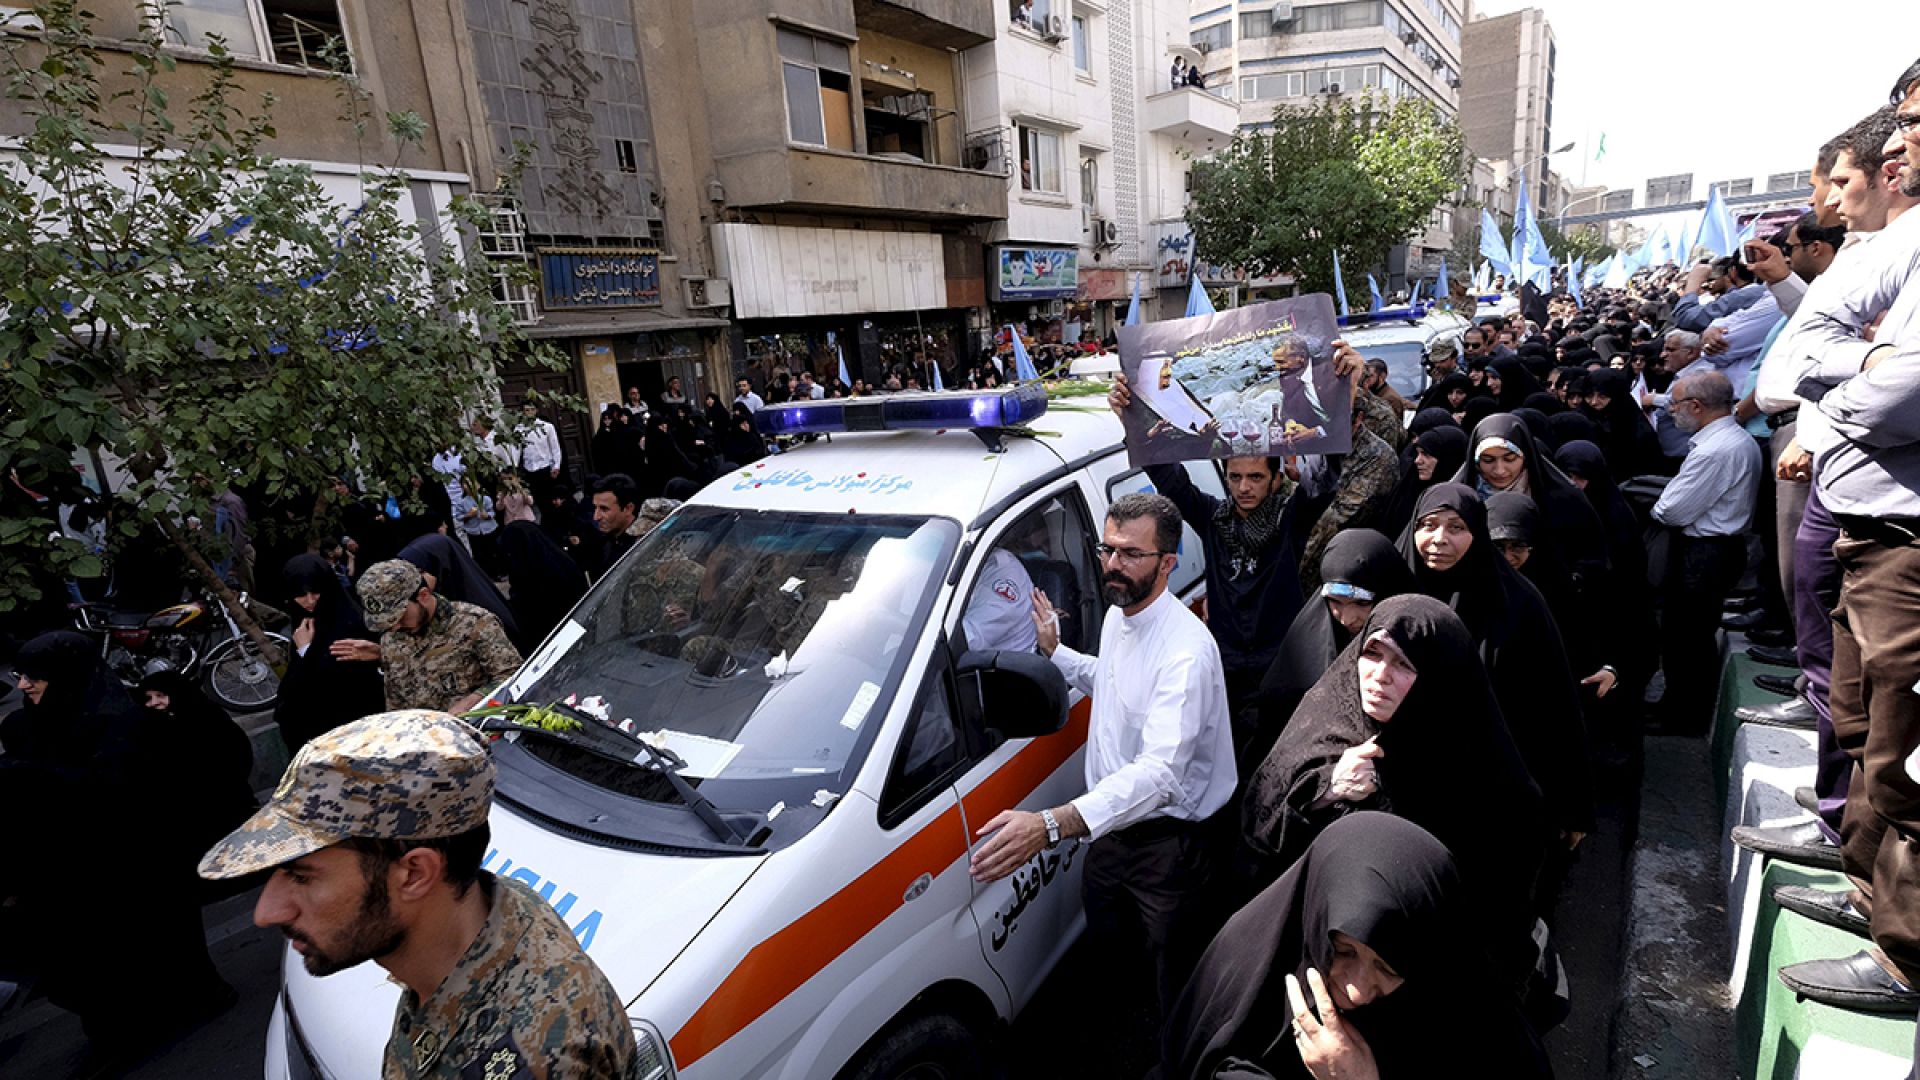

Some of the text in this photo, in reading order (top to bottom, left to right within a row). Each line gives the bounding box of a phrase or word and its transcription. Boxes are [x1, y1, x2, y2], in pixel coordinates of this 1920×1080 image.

[621, 259, 655, 278] خوابگاه
[869, 474, 913, 495] مرکز
[991, 851, 1061, 953] حافظین
